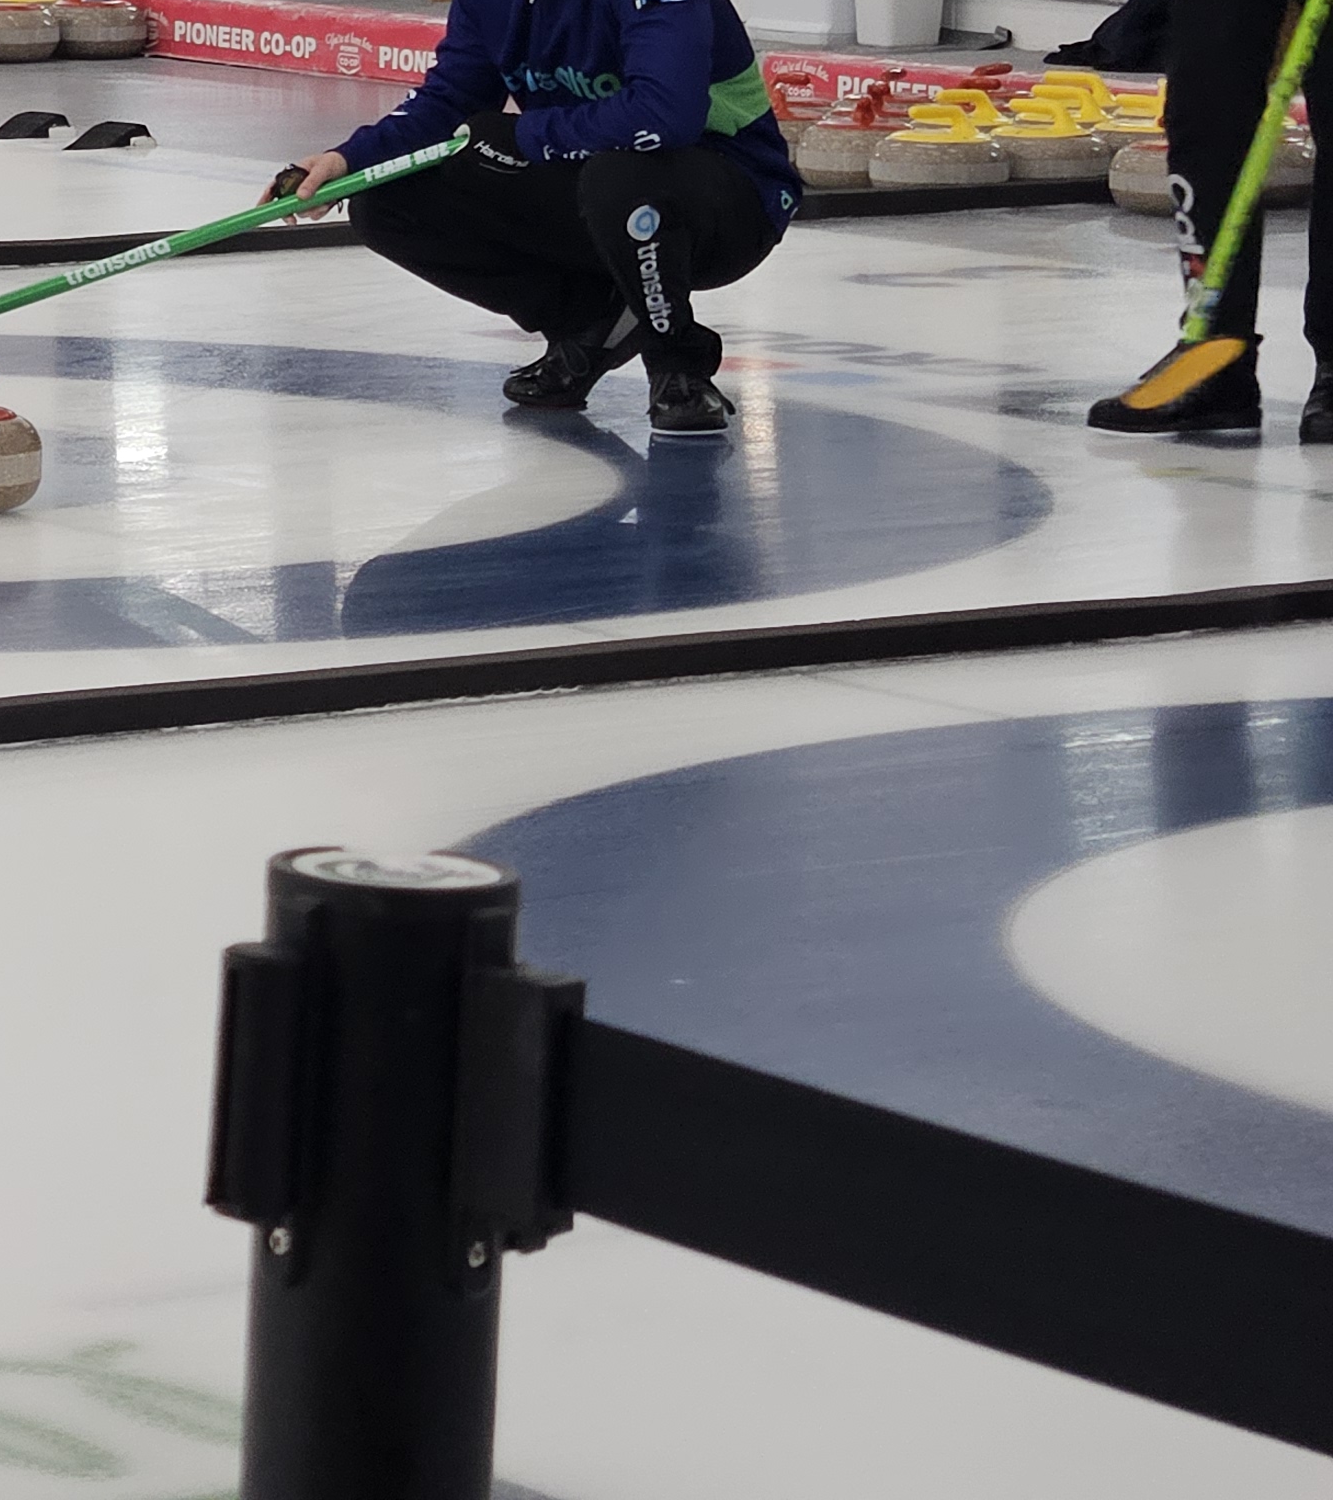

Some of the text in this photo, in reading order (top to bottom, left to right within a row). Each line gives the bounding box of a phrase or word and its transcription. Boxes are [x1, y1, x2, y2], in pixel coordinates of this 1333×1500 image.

[173, 20, 255, 53] PIONEER
[259, 31, 317, 59] CO-OP
[378, 45, 439, 74] PIONE
[63, 238, 171, 286] transalta
[637, 241, 673, 334] transalta
